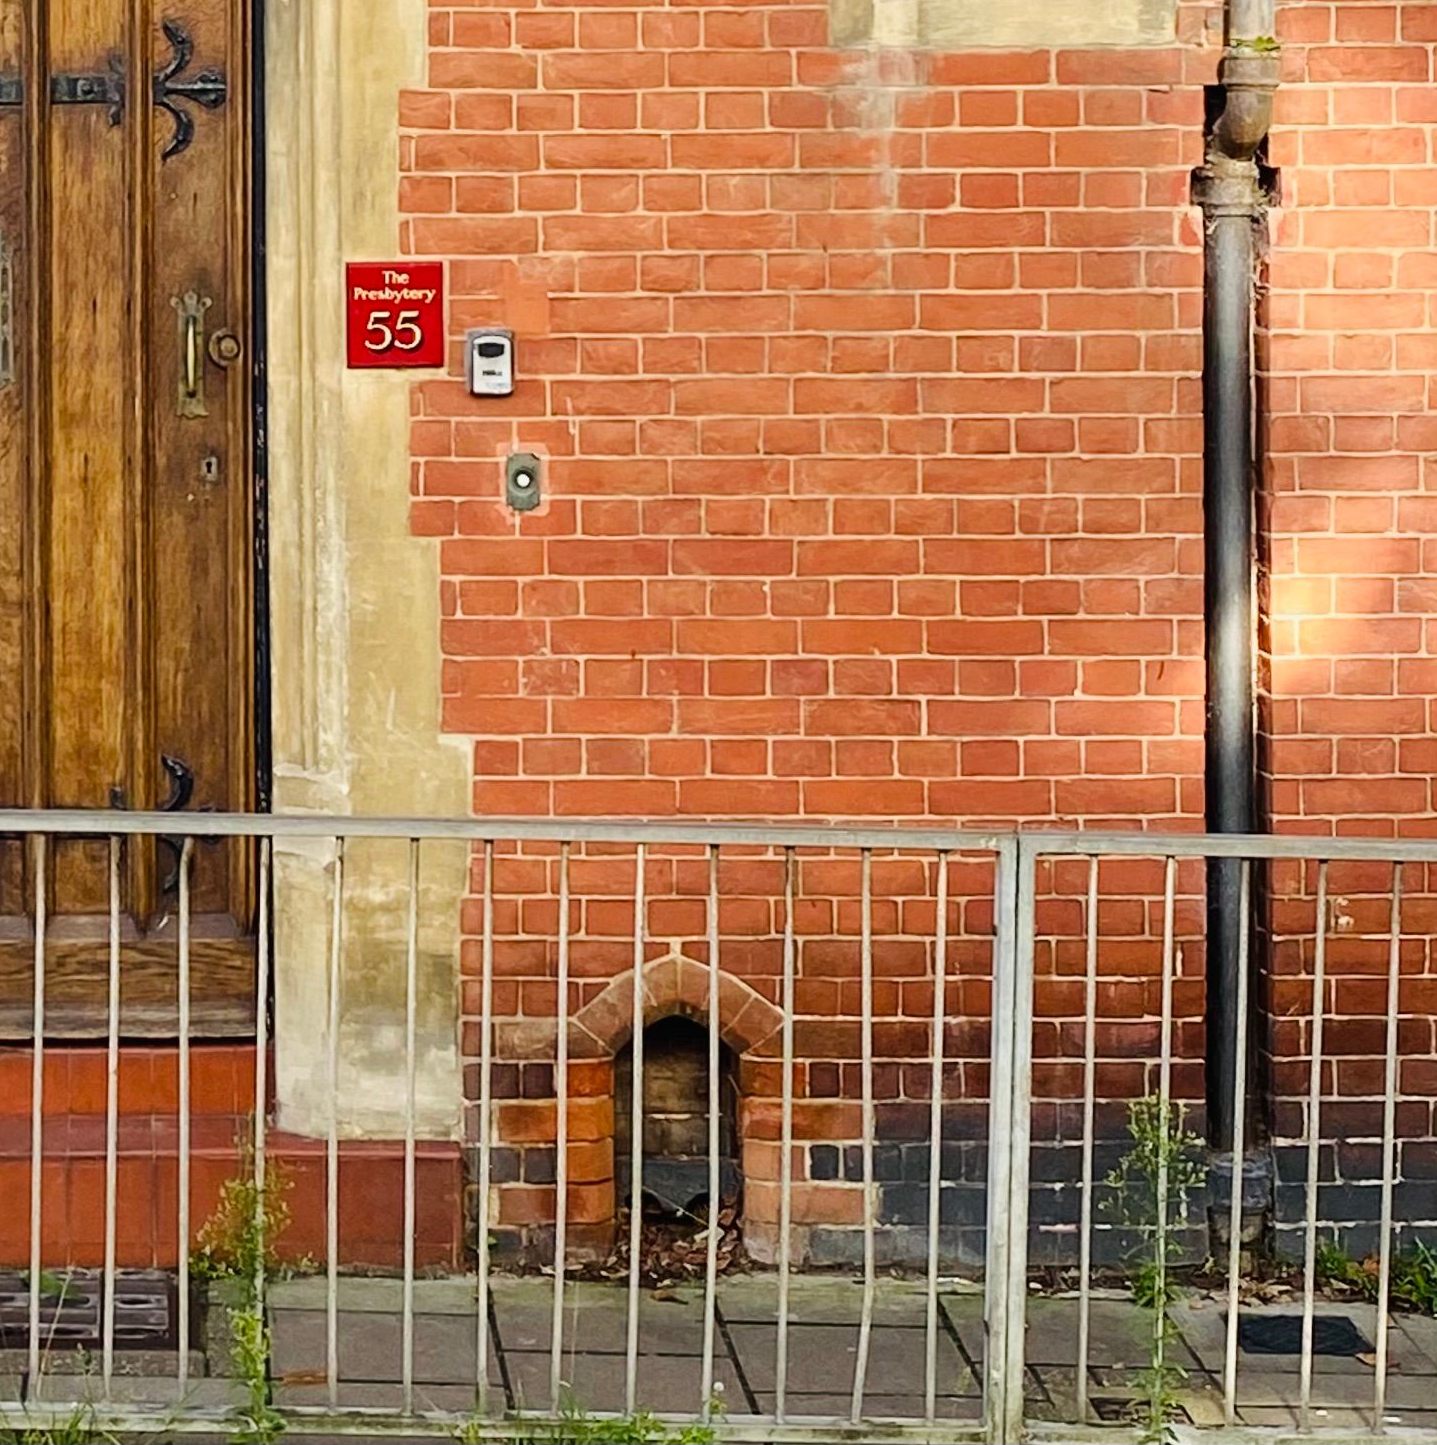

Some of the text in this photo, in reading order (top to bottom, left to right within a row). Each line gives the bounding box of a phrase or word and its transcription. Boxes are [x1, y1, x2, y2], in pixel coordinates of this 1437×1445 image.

[381, 270, 410, 285] The
[353, 286, 437, 304] Presbytery
[364, 310, 422, 350] 55
